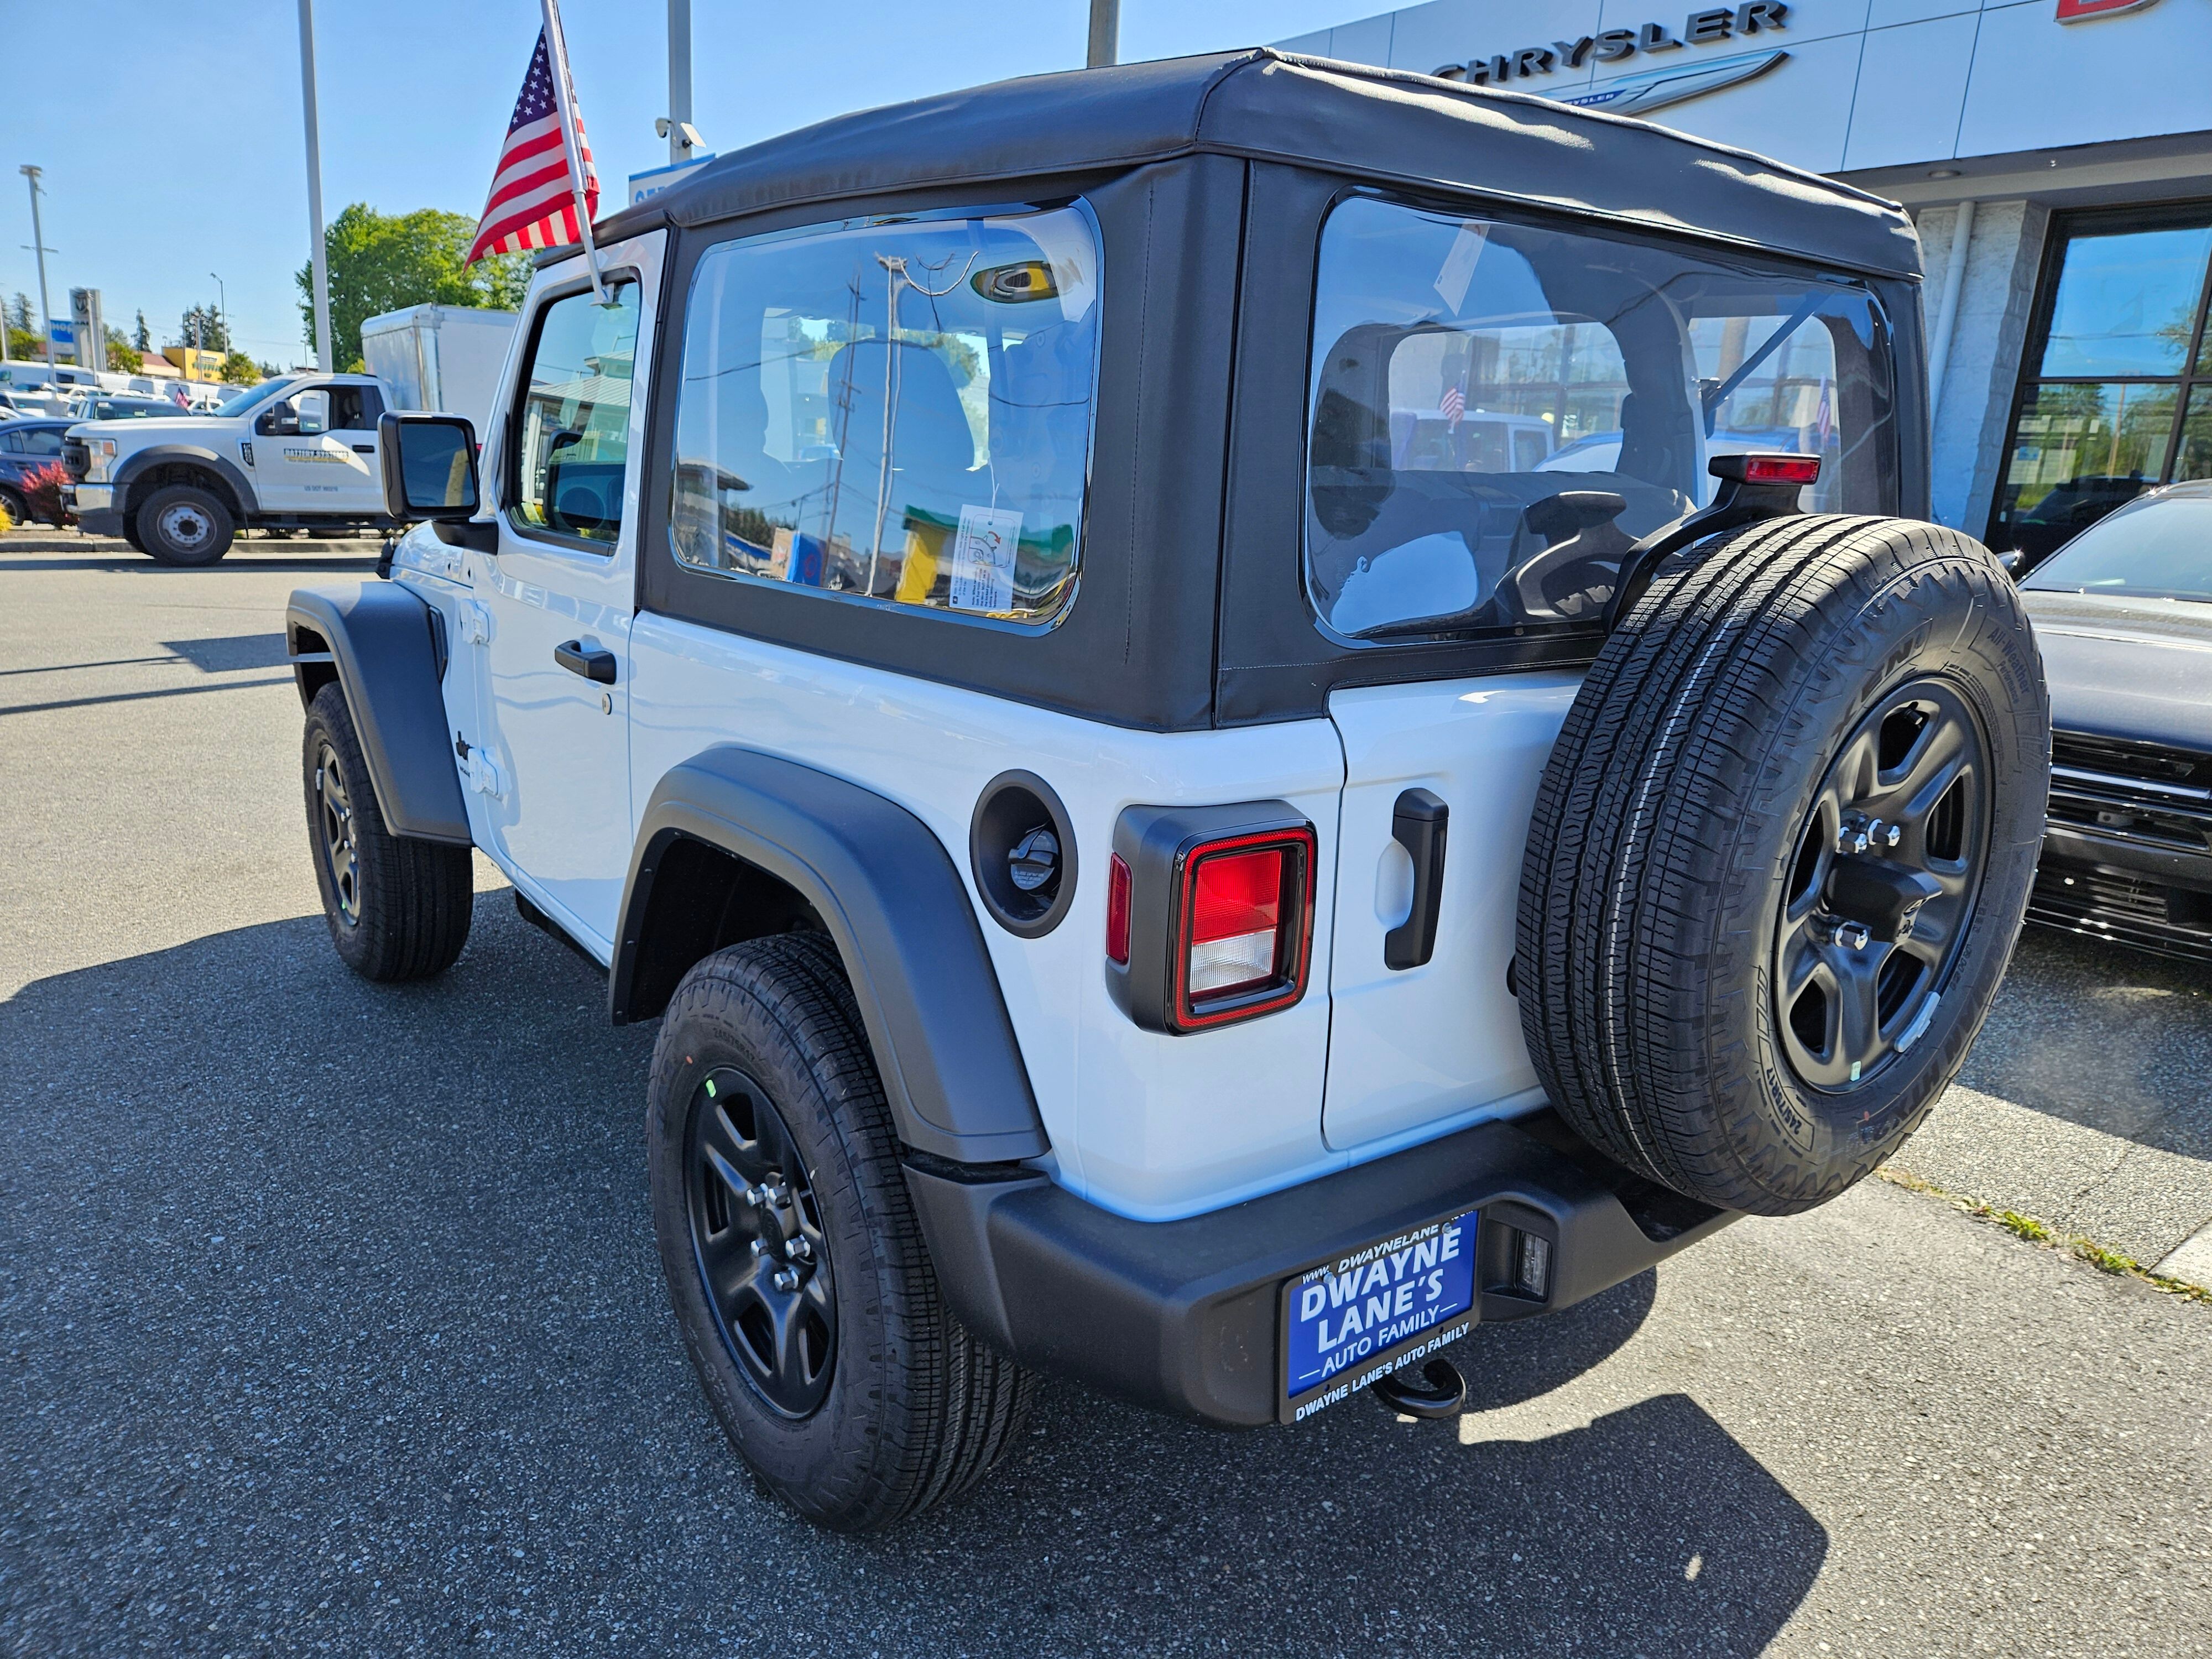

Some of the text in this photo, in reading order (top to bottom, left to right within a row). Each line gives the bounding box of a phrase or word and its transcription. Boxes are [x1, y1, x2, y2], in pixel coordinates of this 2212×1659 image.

[1430, 0, 1788, 84] CHRYSLER
[1987, 627, 2030, 694] All-Weather
[1766, 1067, 1803, 1135] 245/75R17
[1301, 1227, 1462, 1322] DWAYNE
[1338, 1224, 1439, 1273] DWAYNELANE
[1318, 1268, 1444, 1354] LANE'S
[1321, 1305, 1440, 1378] AUTO FAMILY
[1296, 1322, 1469, 1421] DWAYNE LANE'S AUTO FAMILY
